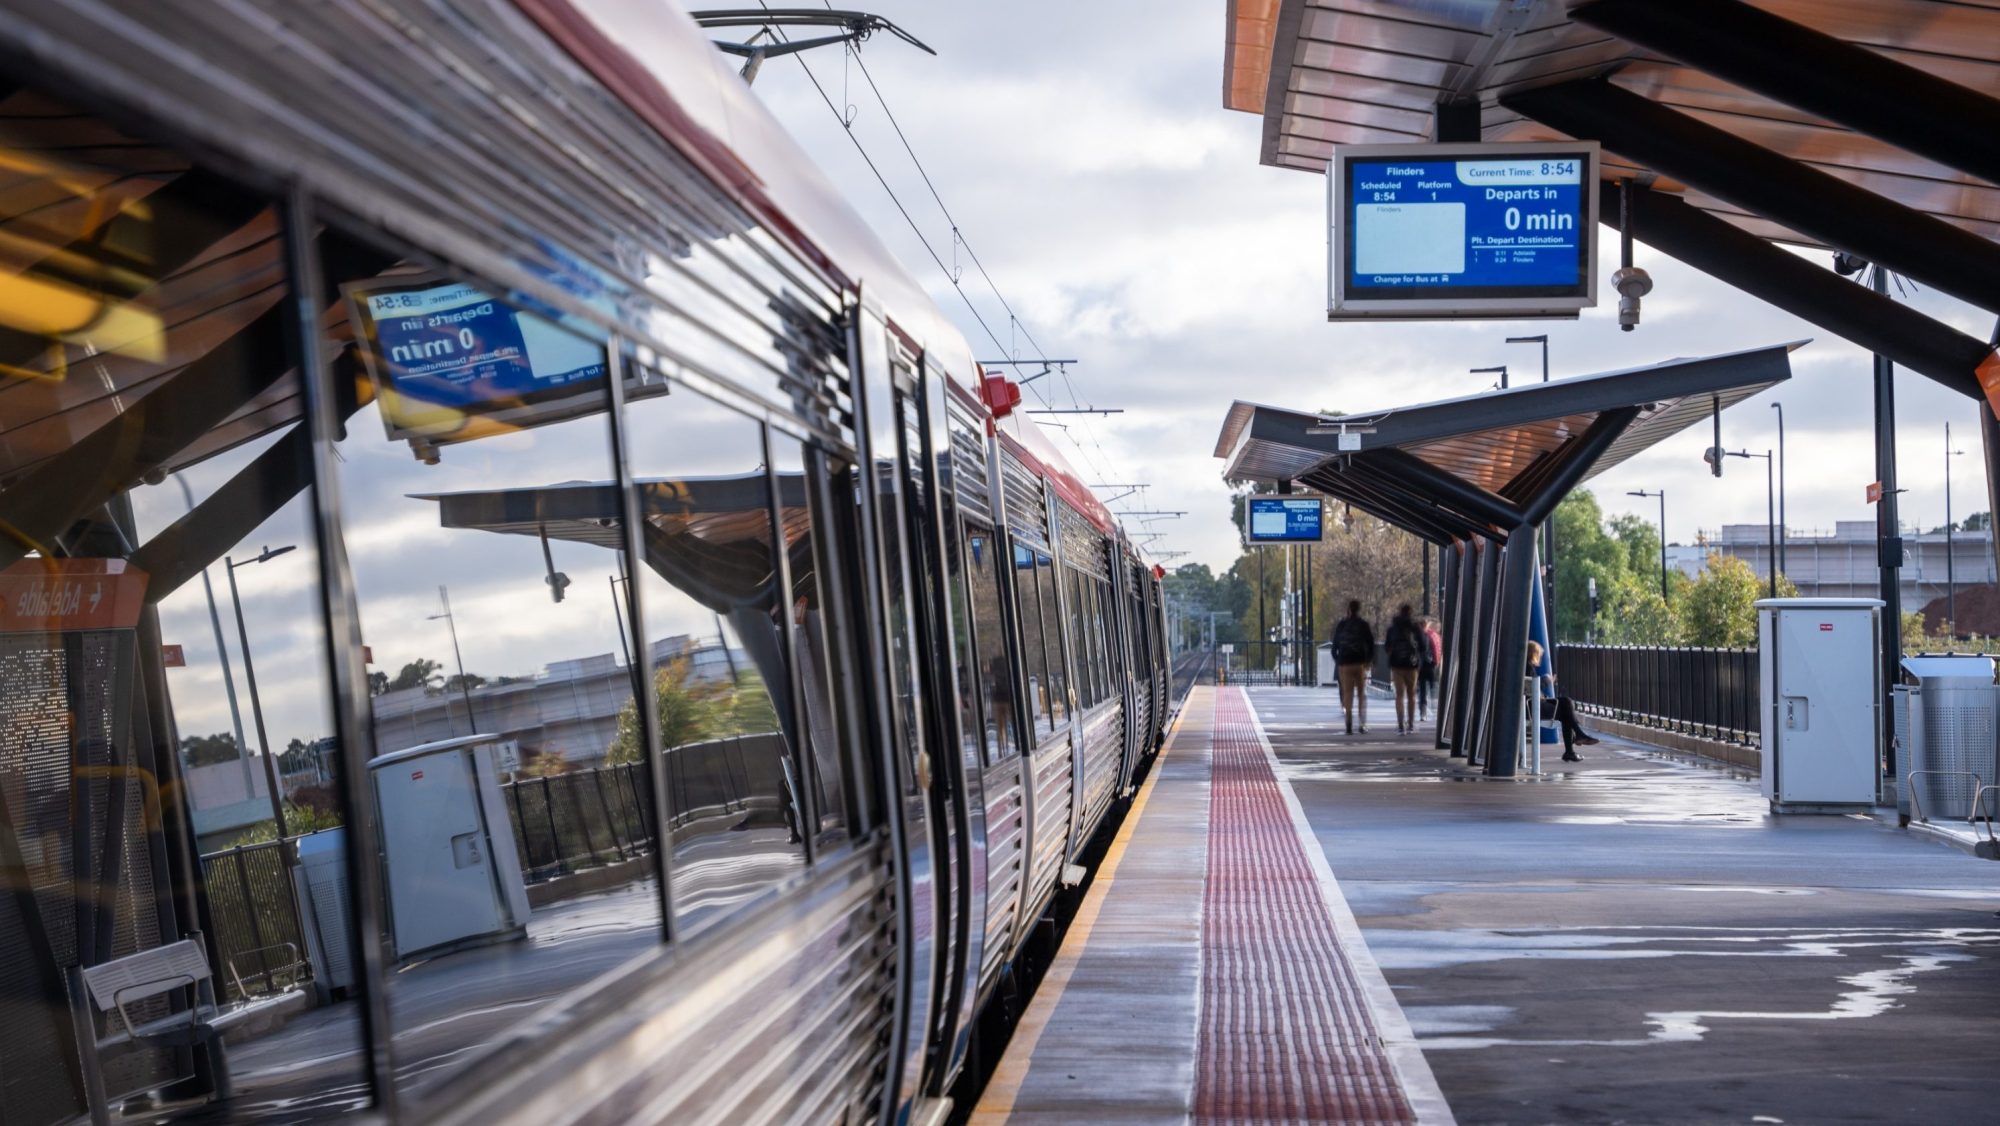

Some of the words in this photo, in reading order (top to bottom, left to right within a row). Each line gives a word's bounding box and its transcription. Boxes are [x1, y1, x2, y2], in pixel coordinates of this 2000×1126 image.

[1386, 167, 1425, 176] Flinders
[1469, 168, 1505, 177] Current
[1509, 167, 1535, 176] Time:
[1541, 162, 1574, 175] 8:54
[1361, 181, 1402, 190] Scheduled
[1417, 181, 1452, 189] Platform
[1374, 191, 1396, 201] 8:54
[1431, 191, 1437, 201] 1
[1485, 187, 1540, 203] Departs
[1544, 187, 1557, 199] in
[1505, 207, 1520, 231] 0
[1526, 208, 1573, 230] min
[1471, 236, 1485, 244] Plt.
[1487, 236, 1515, 245] Depart
[1517, 235, 1564, 244] Destination
[1373, 275, 1401, 284] Change
[1403, 275, 1414, 283] for
